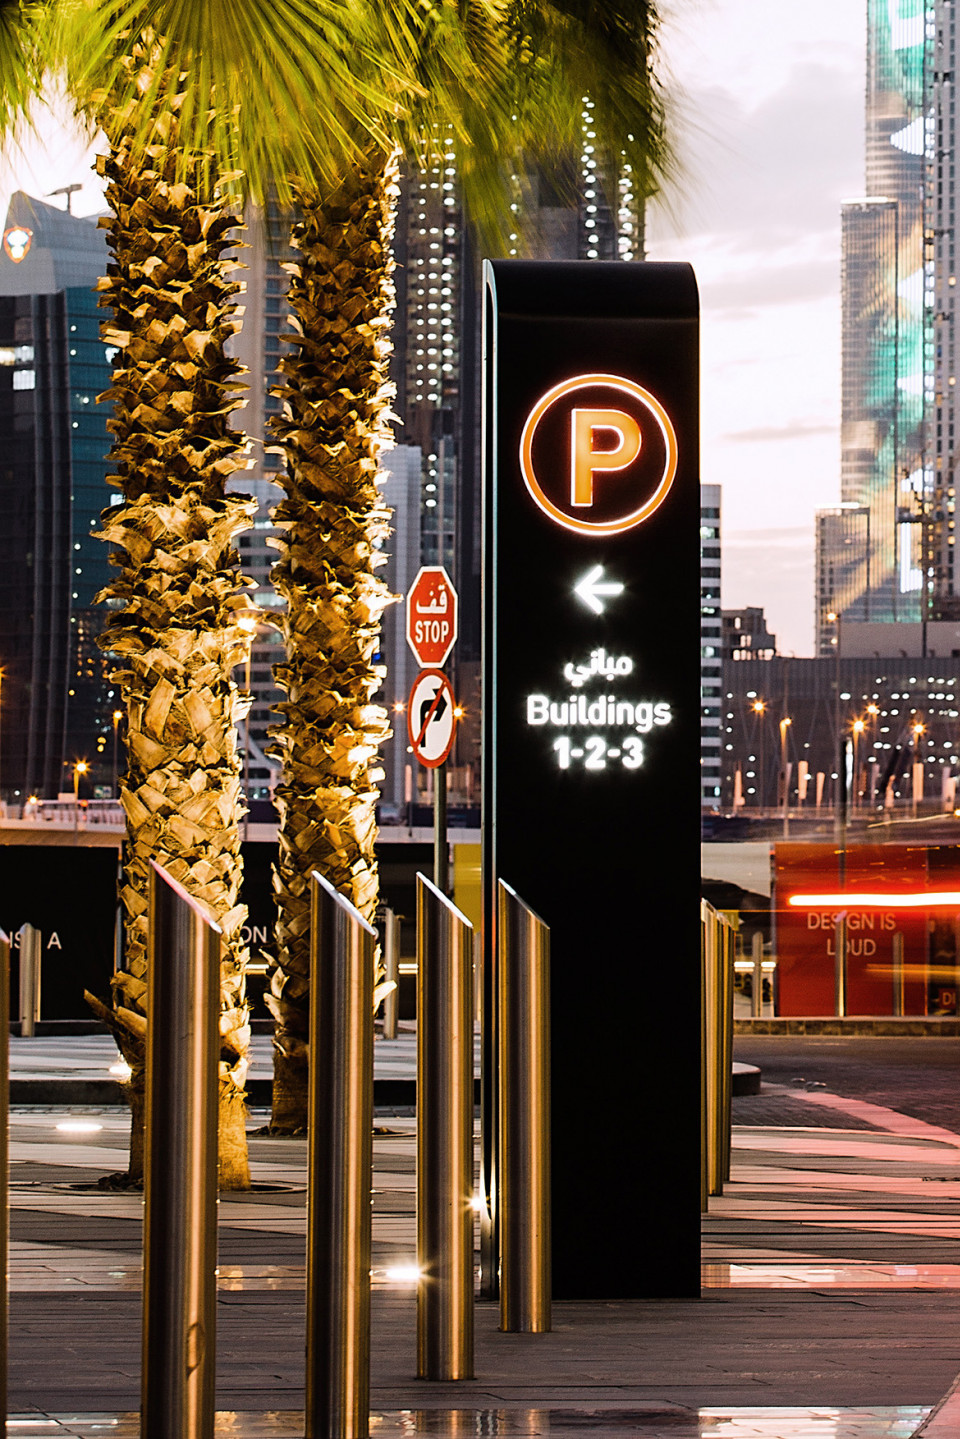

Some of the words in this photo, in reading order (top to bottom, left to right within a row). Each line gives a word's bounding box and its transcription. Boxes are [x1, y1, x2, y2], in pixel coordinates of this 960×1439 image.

[571, 408, 642, 507] P
[416, 585, 448, 614] قف
[415, 620, 449, 643] STOP
[564, 647, 633, 687] مباني
[527, 694, 672, 733] Buildings
[553, 736, 644, 770] 1-2-3
[807, 912, 875, 930] DESGN
[880, 912, 896, 930] IS
[47, 931, 62, 950] A
[827, 937, 876, 956] LUD
